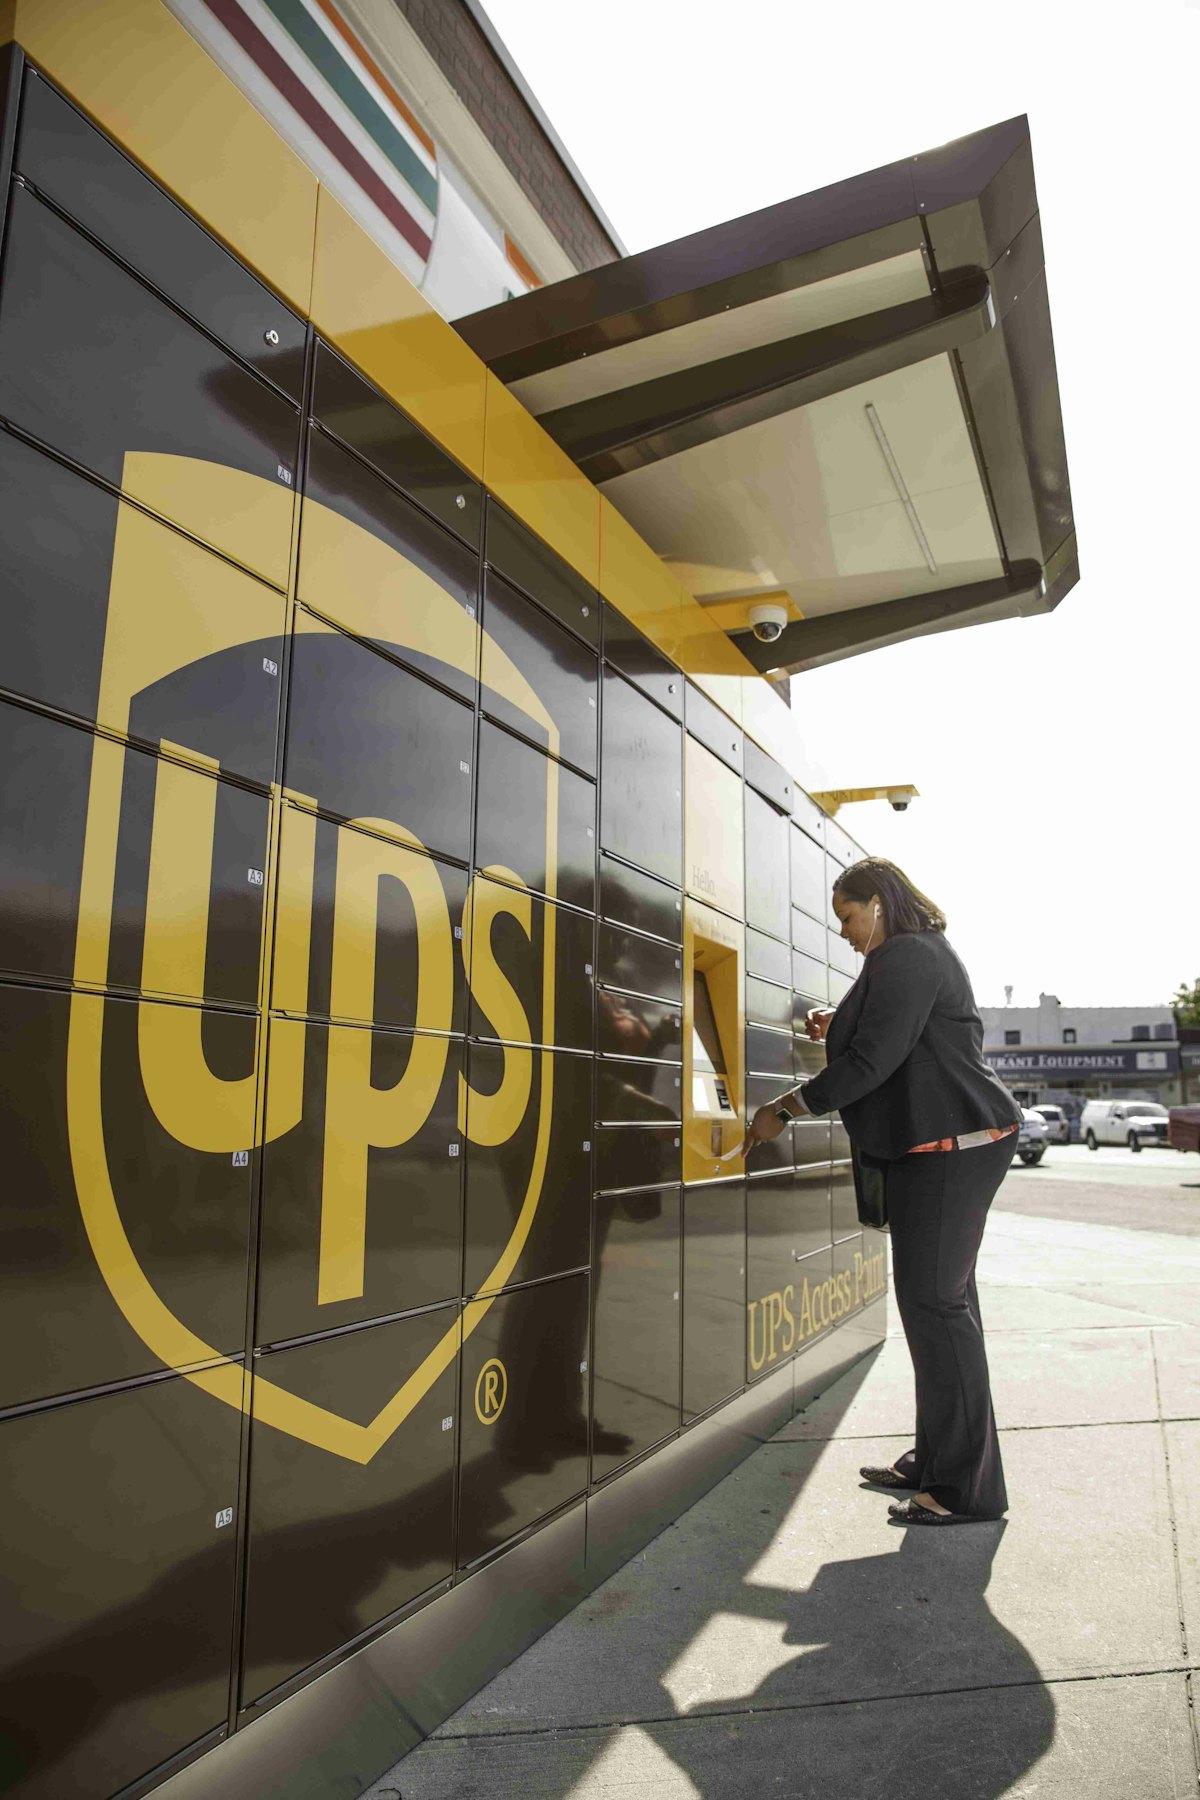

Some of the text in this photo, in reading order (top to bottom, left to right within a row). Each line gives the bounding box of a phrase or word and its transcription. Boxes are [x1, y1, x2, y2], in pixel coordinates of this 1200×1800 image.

[279, 467, 291, 483] A1
[264, 659, 277, 675] A2
[249, 870, 262, 884] A3
[234, 1152, 247, 1166] A4
[748, 1285, 795, 1370] UPS
[798, 1270, 851, 1341] Access
[217, 1508, 232, 1528] A5
